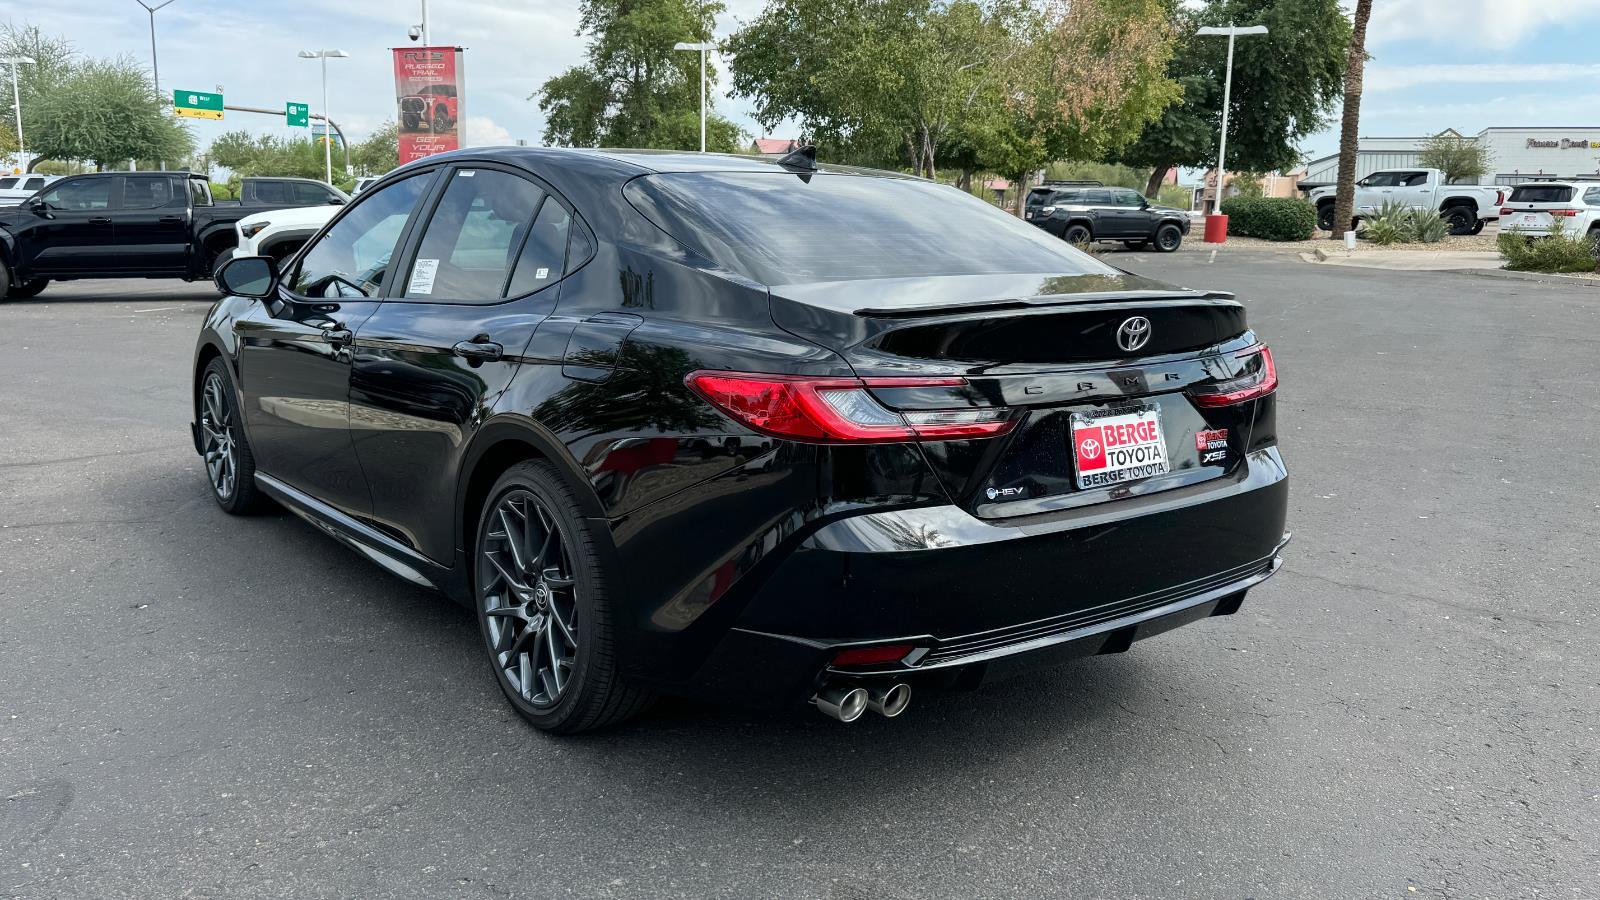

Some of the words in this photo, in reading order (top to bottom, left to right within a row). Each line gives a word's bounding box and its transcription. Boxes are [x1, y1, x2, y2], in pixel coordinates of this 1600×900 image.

[1103, 420, 1158, 447] BERGE
[1207, 440, 1228, 450] TOYOTA
[1107, 445, 1162, 467] TOYOTA
[1202, 450, 1227, 463] XSE
[1083, 469, 1125, 487] BERGE
[1127, 462, 1165, 479] TOYOTA
[996, 486, 1024, 496] HEV
